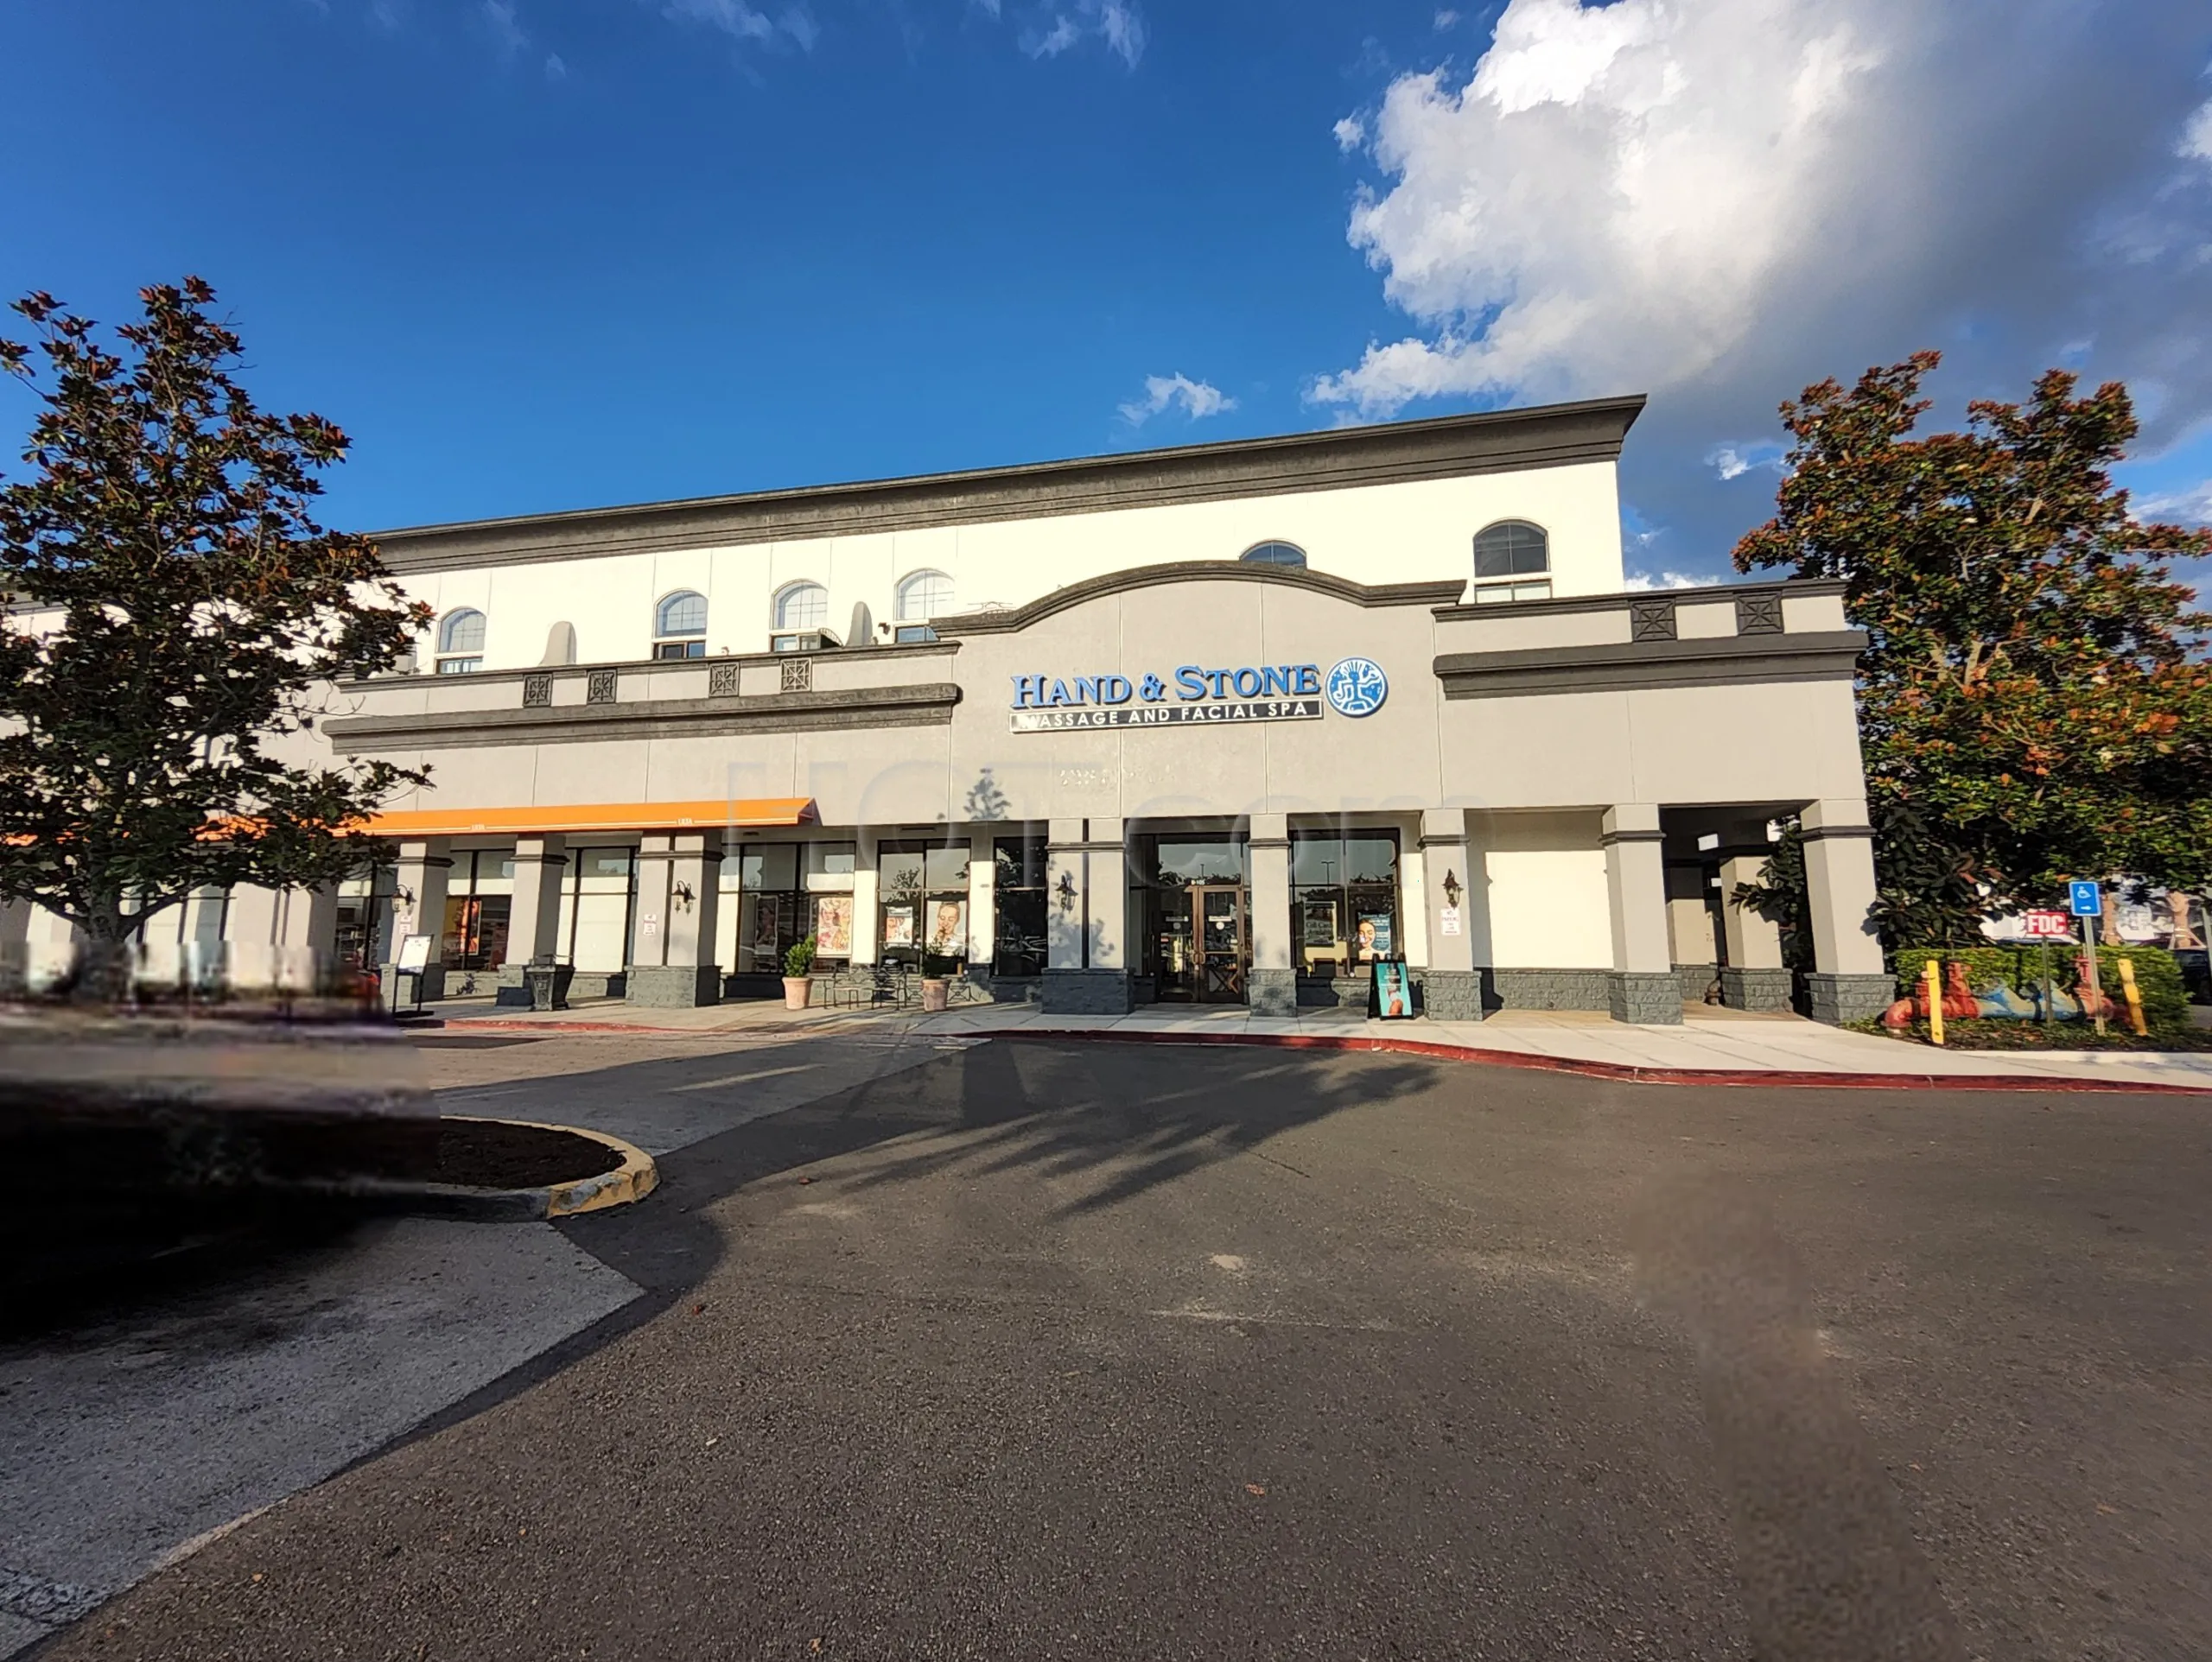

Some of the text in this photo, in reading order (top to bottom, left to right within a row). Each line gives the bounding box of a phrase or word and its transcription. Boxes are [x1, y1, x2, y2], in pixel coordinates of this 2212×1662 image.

[1010, 664, 1321, 708] HAND & STONE
[1128, 708, 1170, 724] AND
[1181, 704, 1257, 720] FACIAL
[1268, 701, 1307, 717] SPA
[2027, 915, 2064, 934] FDC
